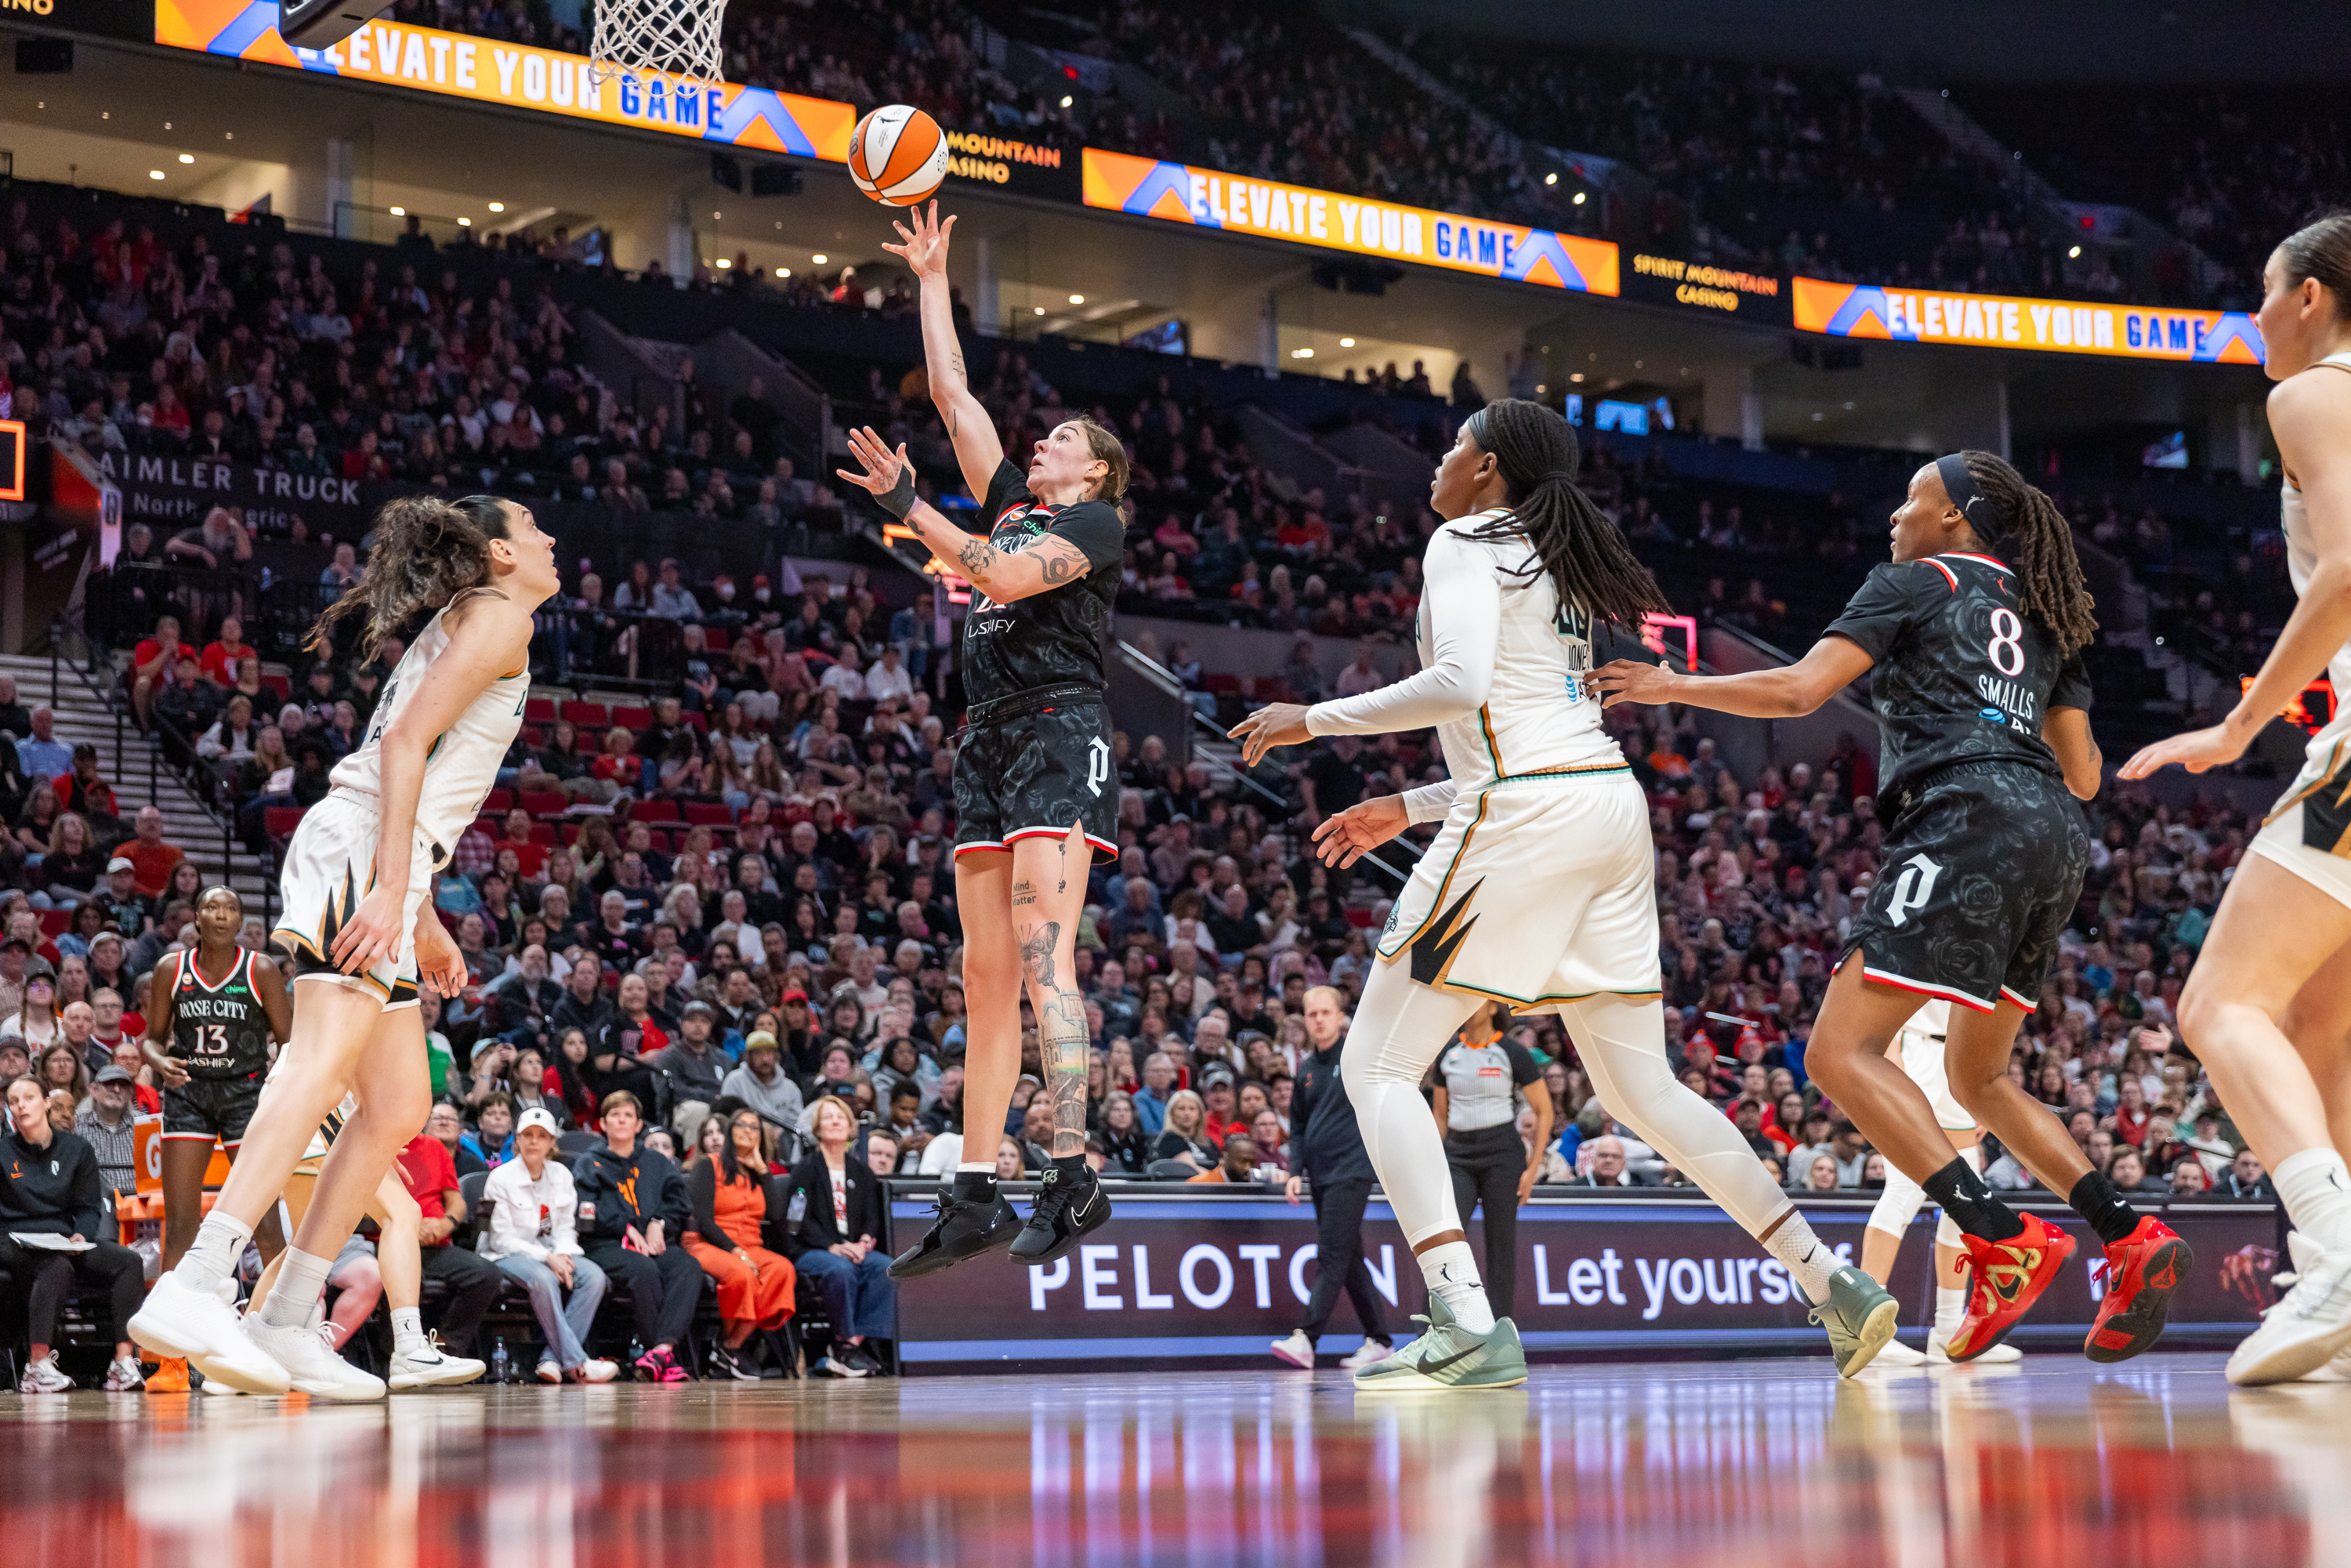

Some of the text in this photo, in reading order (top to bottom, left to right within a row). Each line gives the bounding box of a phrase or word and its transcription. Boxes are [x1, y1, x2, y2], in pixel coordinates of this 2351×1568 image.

[299, 26, 724, 132] EVATE YOUR GAME
[945, 154, 1010, 184] ASINO
[946, 130, 1060, 168] MOUNTAIN
[1189, 173, 1516, 269] ELEVATE YOUR GAME
[1633, 254, 1778, 296] SPIRIT MOUNTAIN
[1675, 284, 1738, 311] CASINO
[1886, 293, 2207, 353] ELEVATE YOUR GAME
[100, 451, 360, 506] AIMLER TRUCK
[1988, 607, 2025, 676] 8
[1978, 674, 2034, 720] SMALLS
[1012, 896, 1037, 907] Matter
[1013, 880, 1030, 893] Mind
[224, 984, 248, 994] chime
[179, 999, 248, 1020] ROSE CITY
[194, 1024, 229, 1054] 13
[1533, 1244, 1627, 1306] Let
[1635, 1243, 1853, 1321] yours
